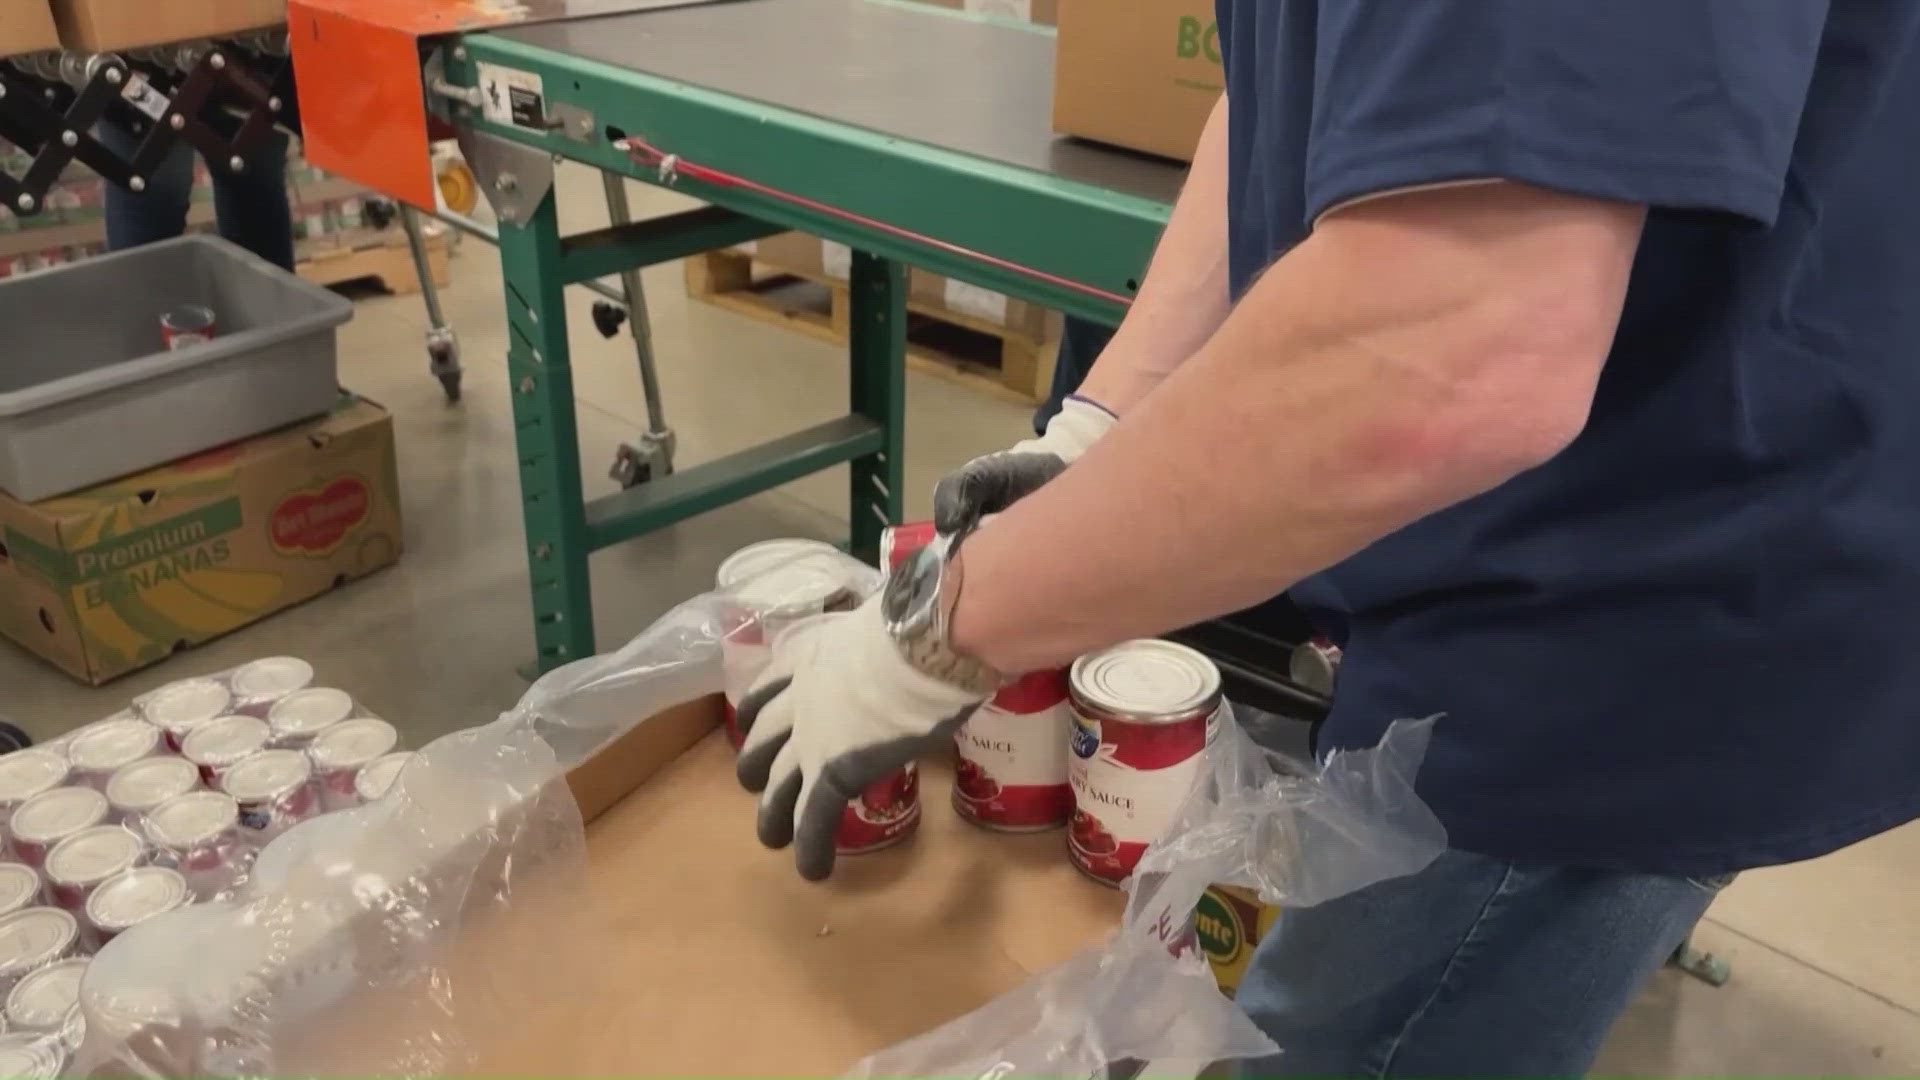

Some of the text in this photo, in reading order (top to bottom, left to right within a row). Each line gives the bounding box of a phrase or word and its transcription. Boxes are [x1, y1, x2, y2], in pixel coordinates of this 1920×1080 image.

[77, 520, 206, 577] Premium
[972, 734, 1017, 754] SAUCE
[1090, 785, 1135, 811] SAUCE
